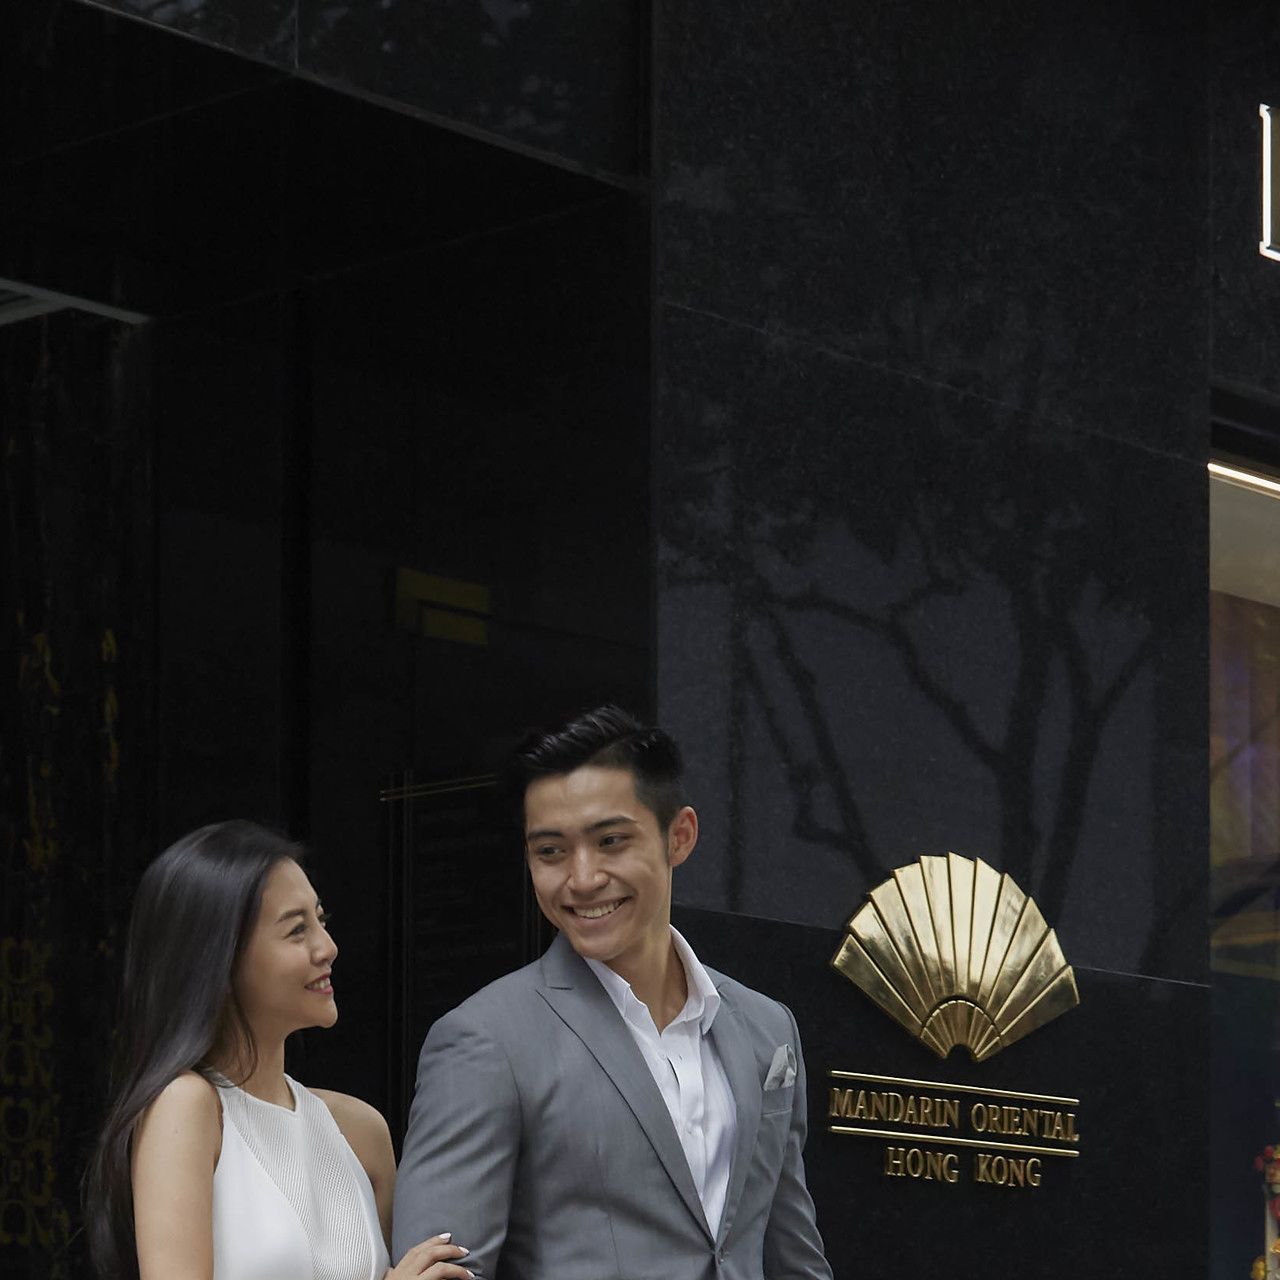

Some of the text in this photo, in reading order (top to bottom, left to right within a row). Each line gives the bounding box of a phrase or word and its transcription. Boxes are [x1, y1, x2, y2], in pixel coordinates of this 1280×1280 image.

[830, 1086, 1081, 1142] MANDARIN ORIENTAL
[883, 1146, 1043, 1187] HONG KONG
